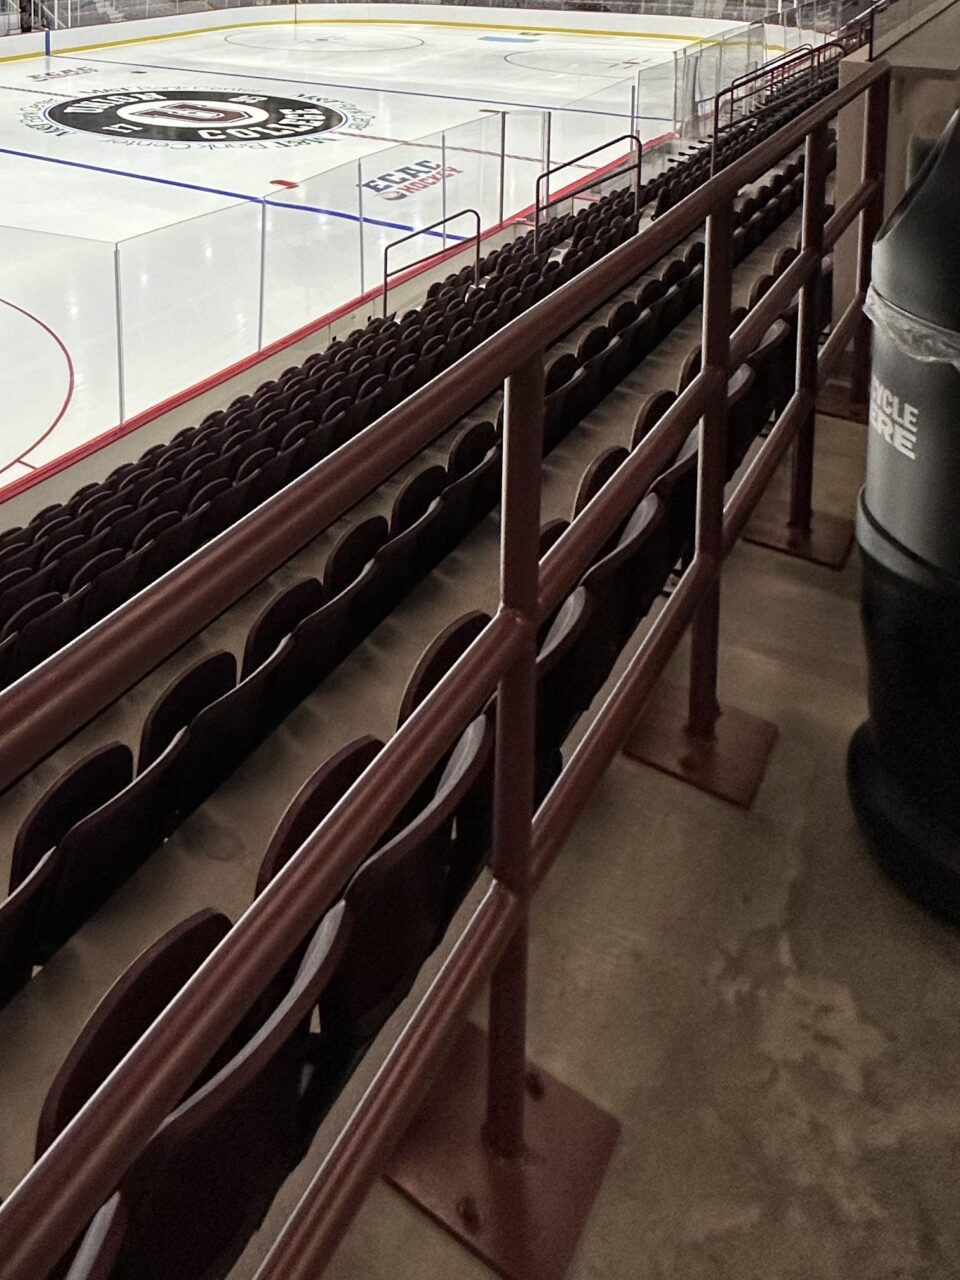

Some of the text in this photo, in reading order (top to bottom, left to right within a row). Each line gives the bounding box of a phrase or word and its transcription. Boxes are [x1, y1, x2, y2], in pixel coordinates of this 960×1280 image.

[63, 92, 168, 114] UNION
[197, 107, 328, 141] COLLEGE
[361, 159, 442, 193] ECAC
[396, 166, 464, 194] HOCKEY
[871, 375, 919, 433] YCLE
